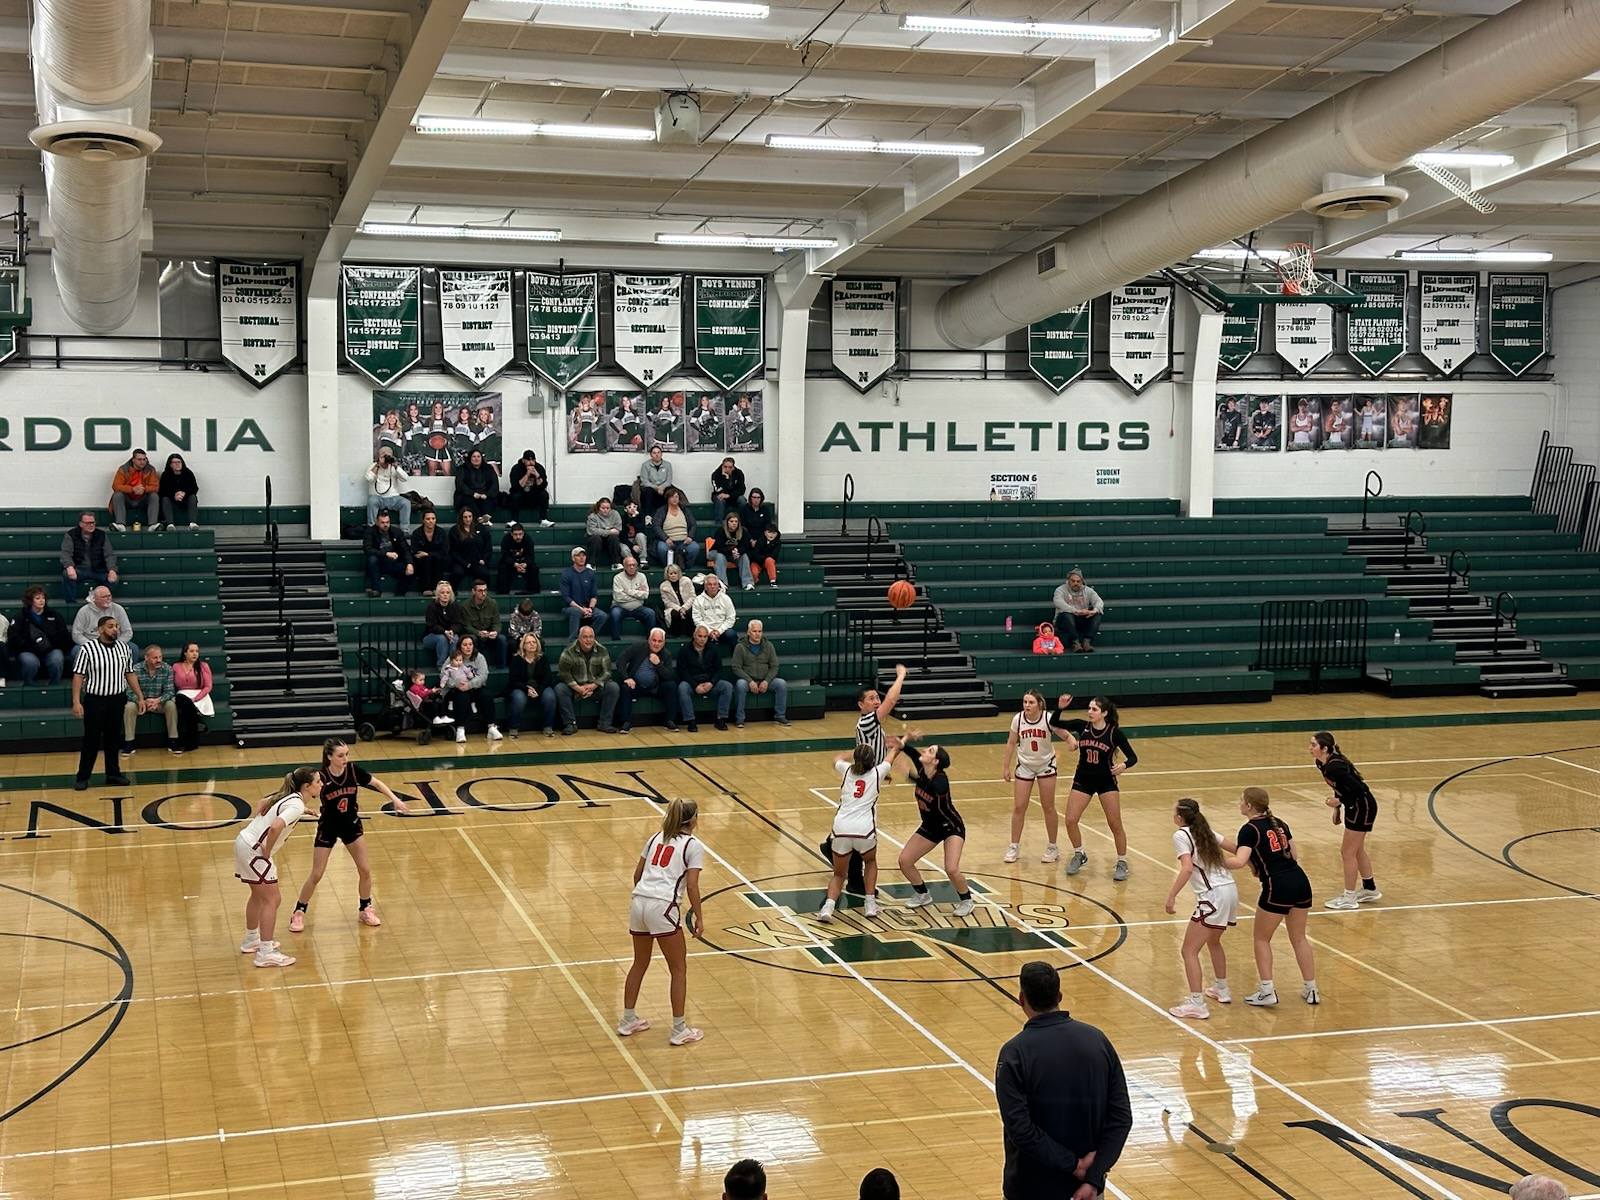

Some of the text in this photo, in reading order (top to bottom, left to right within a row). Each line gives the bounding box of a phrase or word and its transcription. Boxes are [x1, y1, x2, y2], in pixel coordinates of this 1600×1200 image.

[374, 269, 415, 279] BOWLING
[530, 275, 593, 286] BOYS BAKETBALL
[702, 280, 756, 288] BOYS TENNIS
[1360, 276, 1396, 284] FOOTBALL
[235, 288, 282, 297] CONFERENCE
[360, 290, 405, 300] CONFERENCE
[708, 300, 749, 308] CONFERENCE
[1501, 295, 1535, 304] CONFERENCE
[239, 316, 279, 325] SECTIONAL
[363, 319, 402, 328] SECTIONAL
[1355, 318, 1399, 326] STATE PLAYOFFS
[1505, 320, 1529, 328] DISTRICT
[462, 321, 493, 330] DISTRICT
[547, 325, 578, 334] DISTRICT
[631, 324, 666, 333] SECTIONAL
[712, 326, 746, 335] SECTIONAL
[850, 328, 878, 336] DISTRICT
[1046, 331, 1073, 339] DISTRICT
[243, 339, 276, 347] DISTRICT
[367, 341, 400, 350] DISTRICT
[461, 343, 495, 351] REGIONAL
[546, 346, 579, 355] REGIONAL
[633, 346, 663, 354] DISTRICT
[714, 347, 743, 355] DISTRICT
[849, 348, 879, 357] REGIONAL
[1044, 351, 1074, 359] REGIONAL
[1126, 351, 1152, 359] DISTRICT
[1300, 358, 1308, 368] N
[1443, 358, 1452, 369] N
[254, 364, 266, 376] N
[474, 367, 486, 378] N
[643, 369, 653, 380] N
[858, 371, 868, 382] N
[1133, 373, 1143, 384] N
[819, 421, 1150, 452] ATHLETICS
[1096, 468, 1120, 476] STUDENT
[990, 474, 1038, 482] SECTION 6
[1096, 477, 1120, 485] SECTION
[1086, 749, 1099, 764] 11
[853, 779, 866, 799] 3
[336, 797, 348, 813] 4
[651, 843, 676, 868] 10
[723, 902, 1070, 948] KNIGHTS
